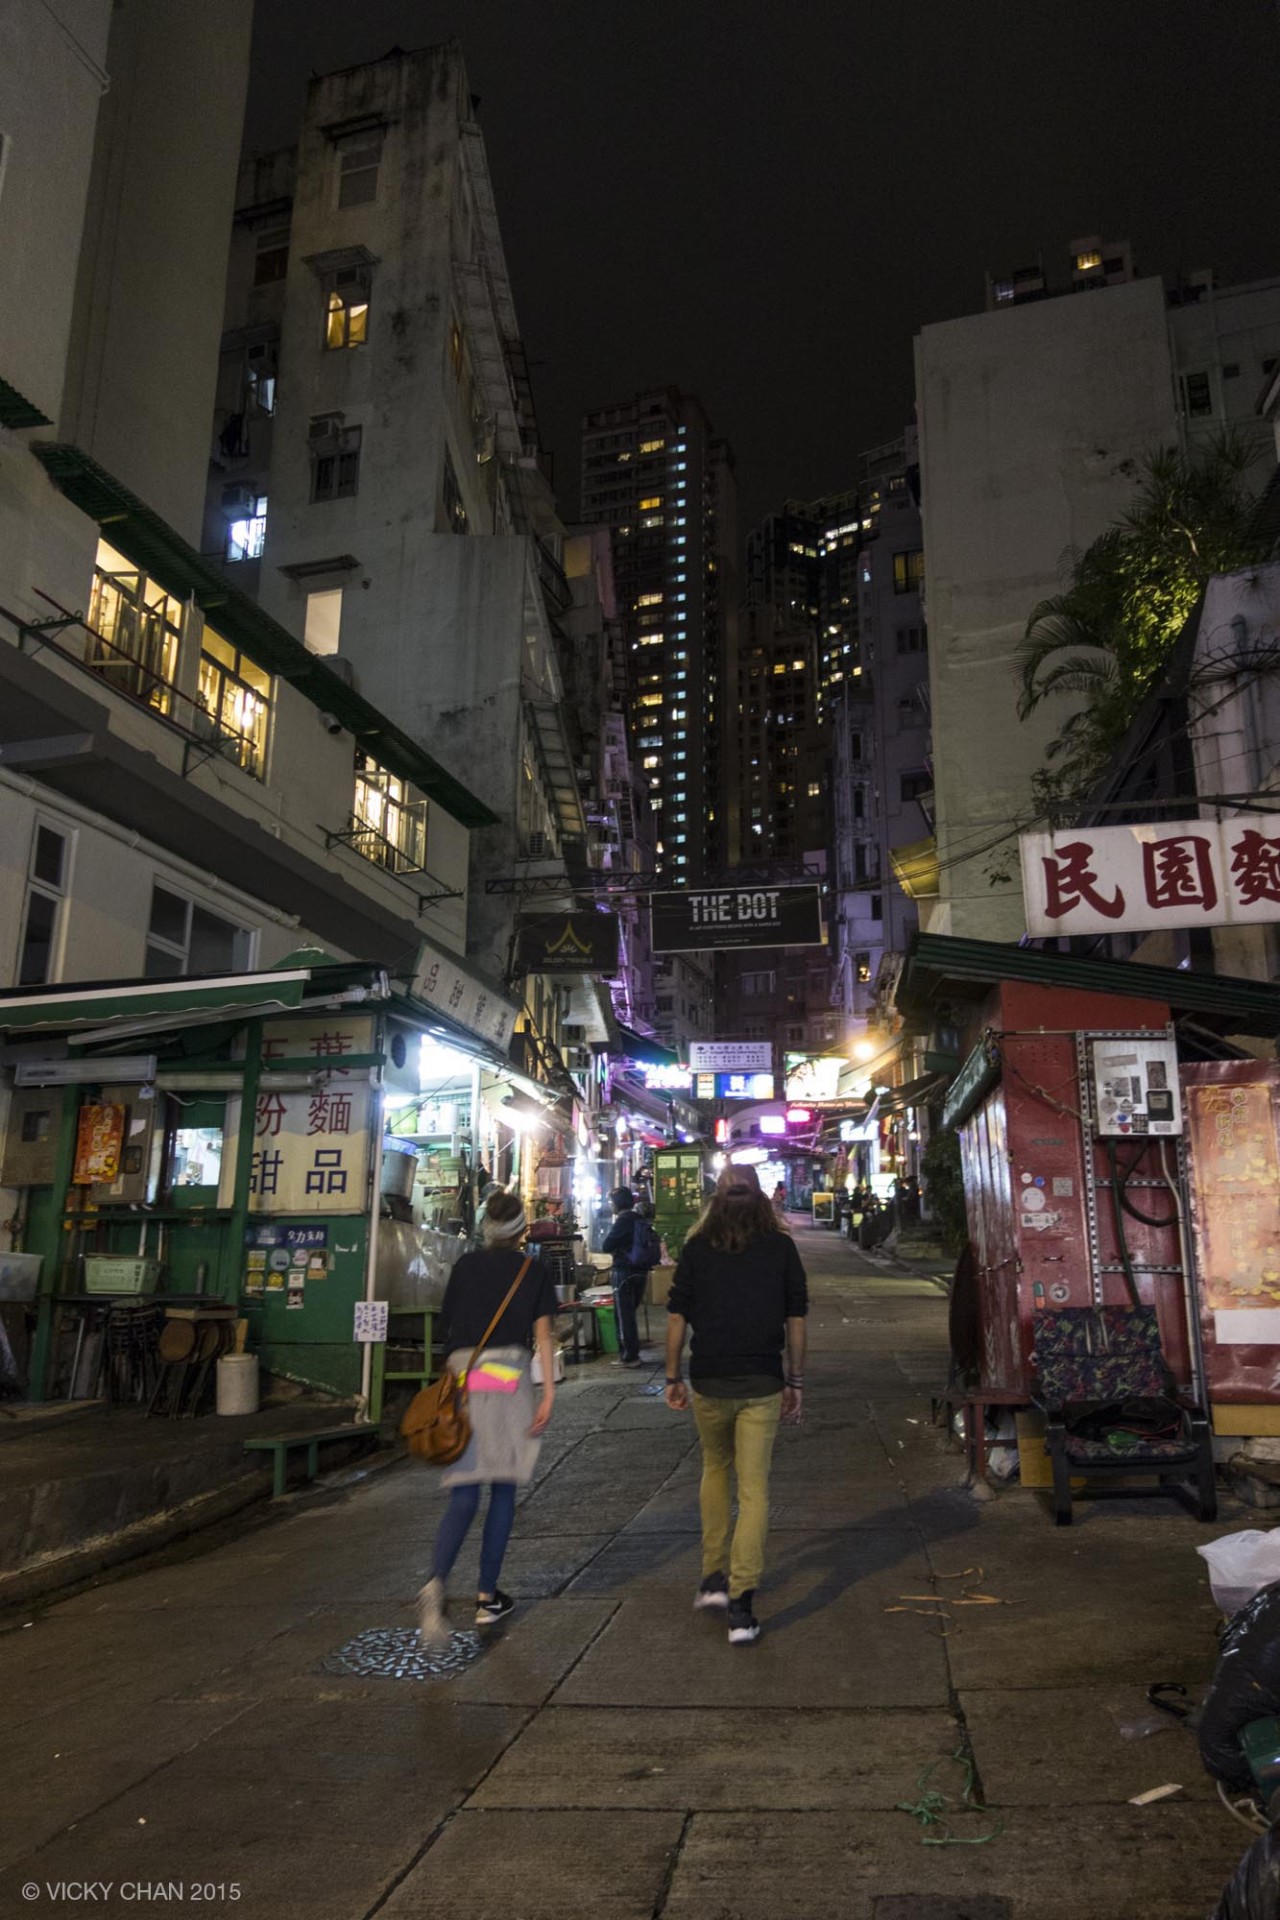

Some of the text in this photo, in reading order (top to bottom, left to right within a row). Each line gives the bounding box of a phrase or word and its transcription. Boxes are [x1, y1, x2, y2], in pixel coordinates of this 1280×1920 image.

[688, 892, 780, 923] THE DOT
[249, 1149, 347, 1195] 甜品
